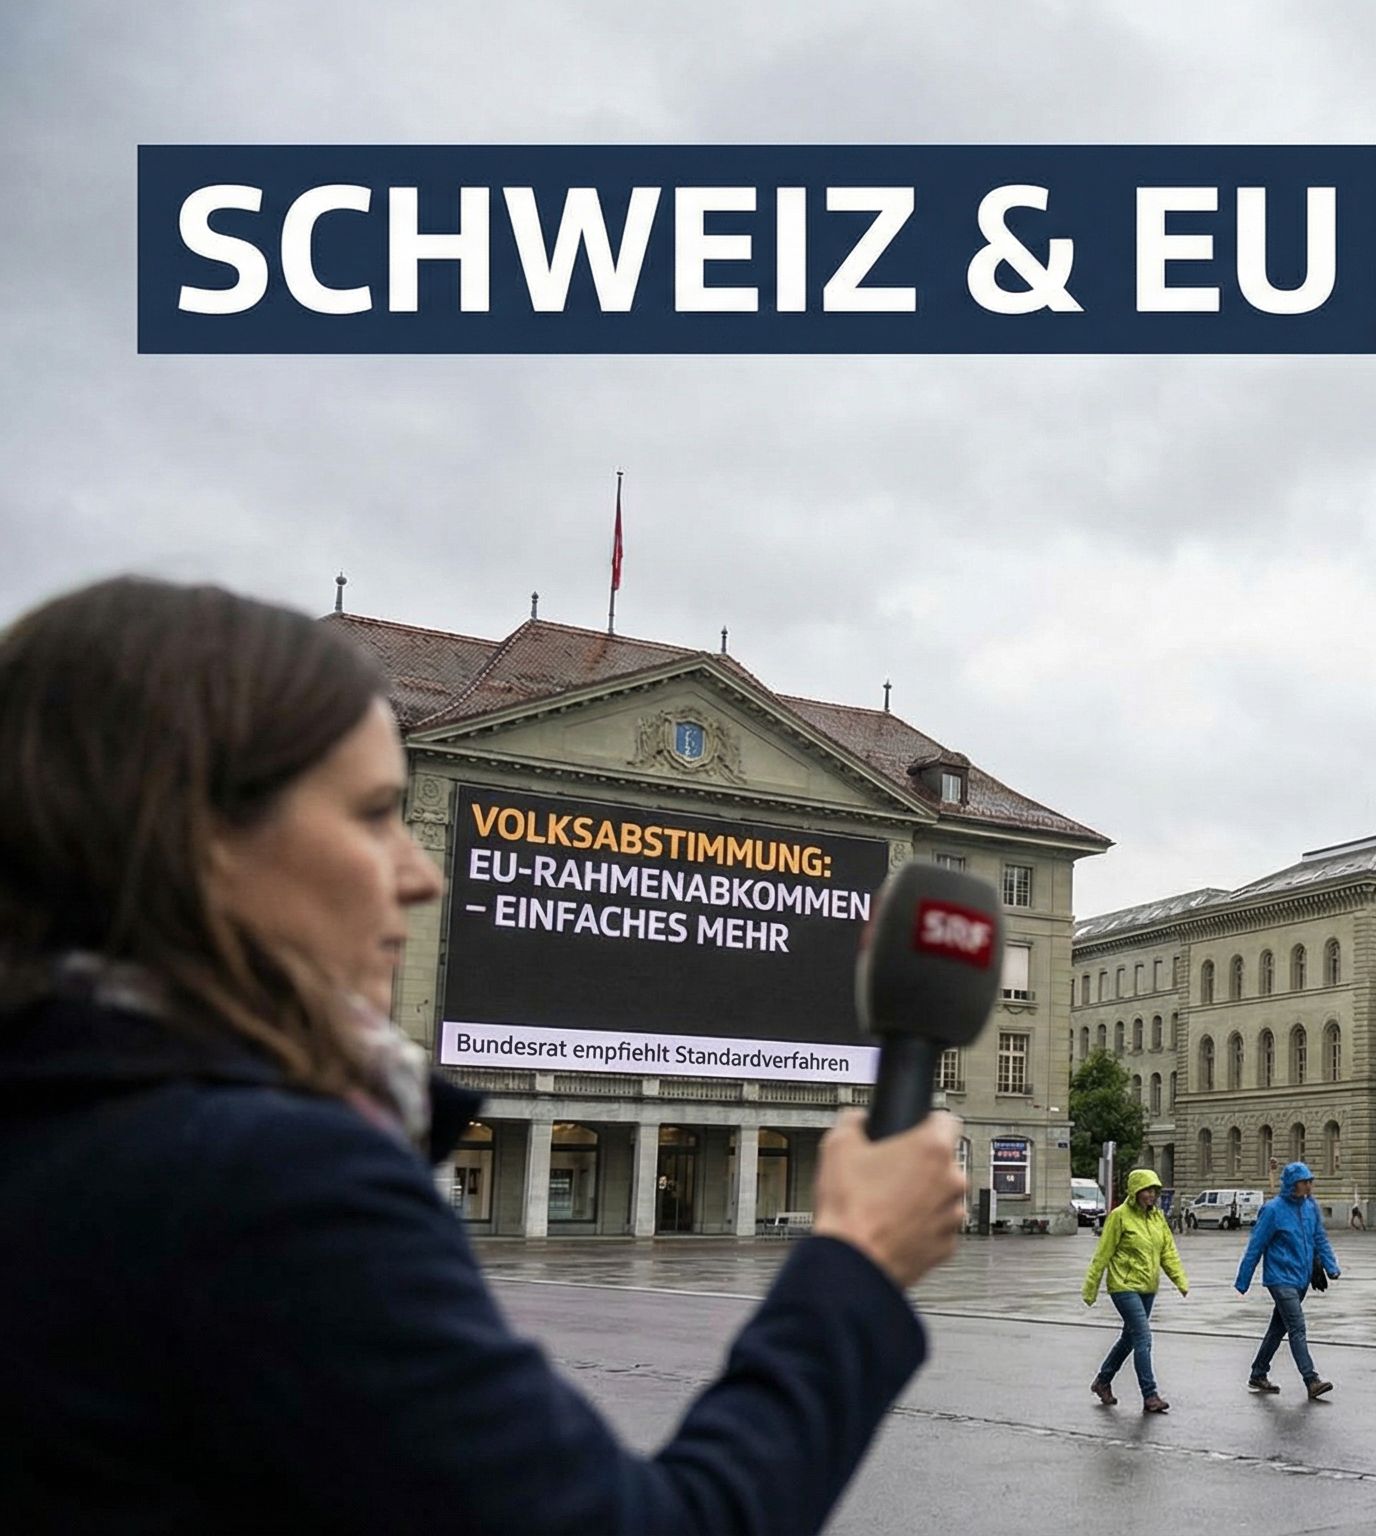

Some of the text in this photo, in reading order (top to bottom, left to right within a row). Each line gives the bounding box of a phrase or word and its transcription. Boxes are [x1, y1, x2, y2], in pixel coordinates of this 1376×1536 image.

[471, 803, 832, 878] VOLKSABSTIMMUNG:
[469, 848, 870, 922] EU-RAHMENABKOMMEN
[494, 895, 688, 943] EINFACHES
[696, 914, 790, 953] MEHR
[922, 909, 992, 954] SRF
[456, 1033, 849, 1072] Bundesrat empfiehlt Standardverfahren
